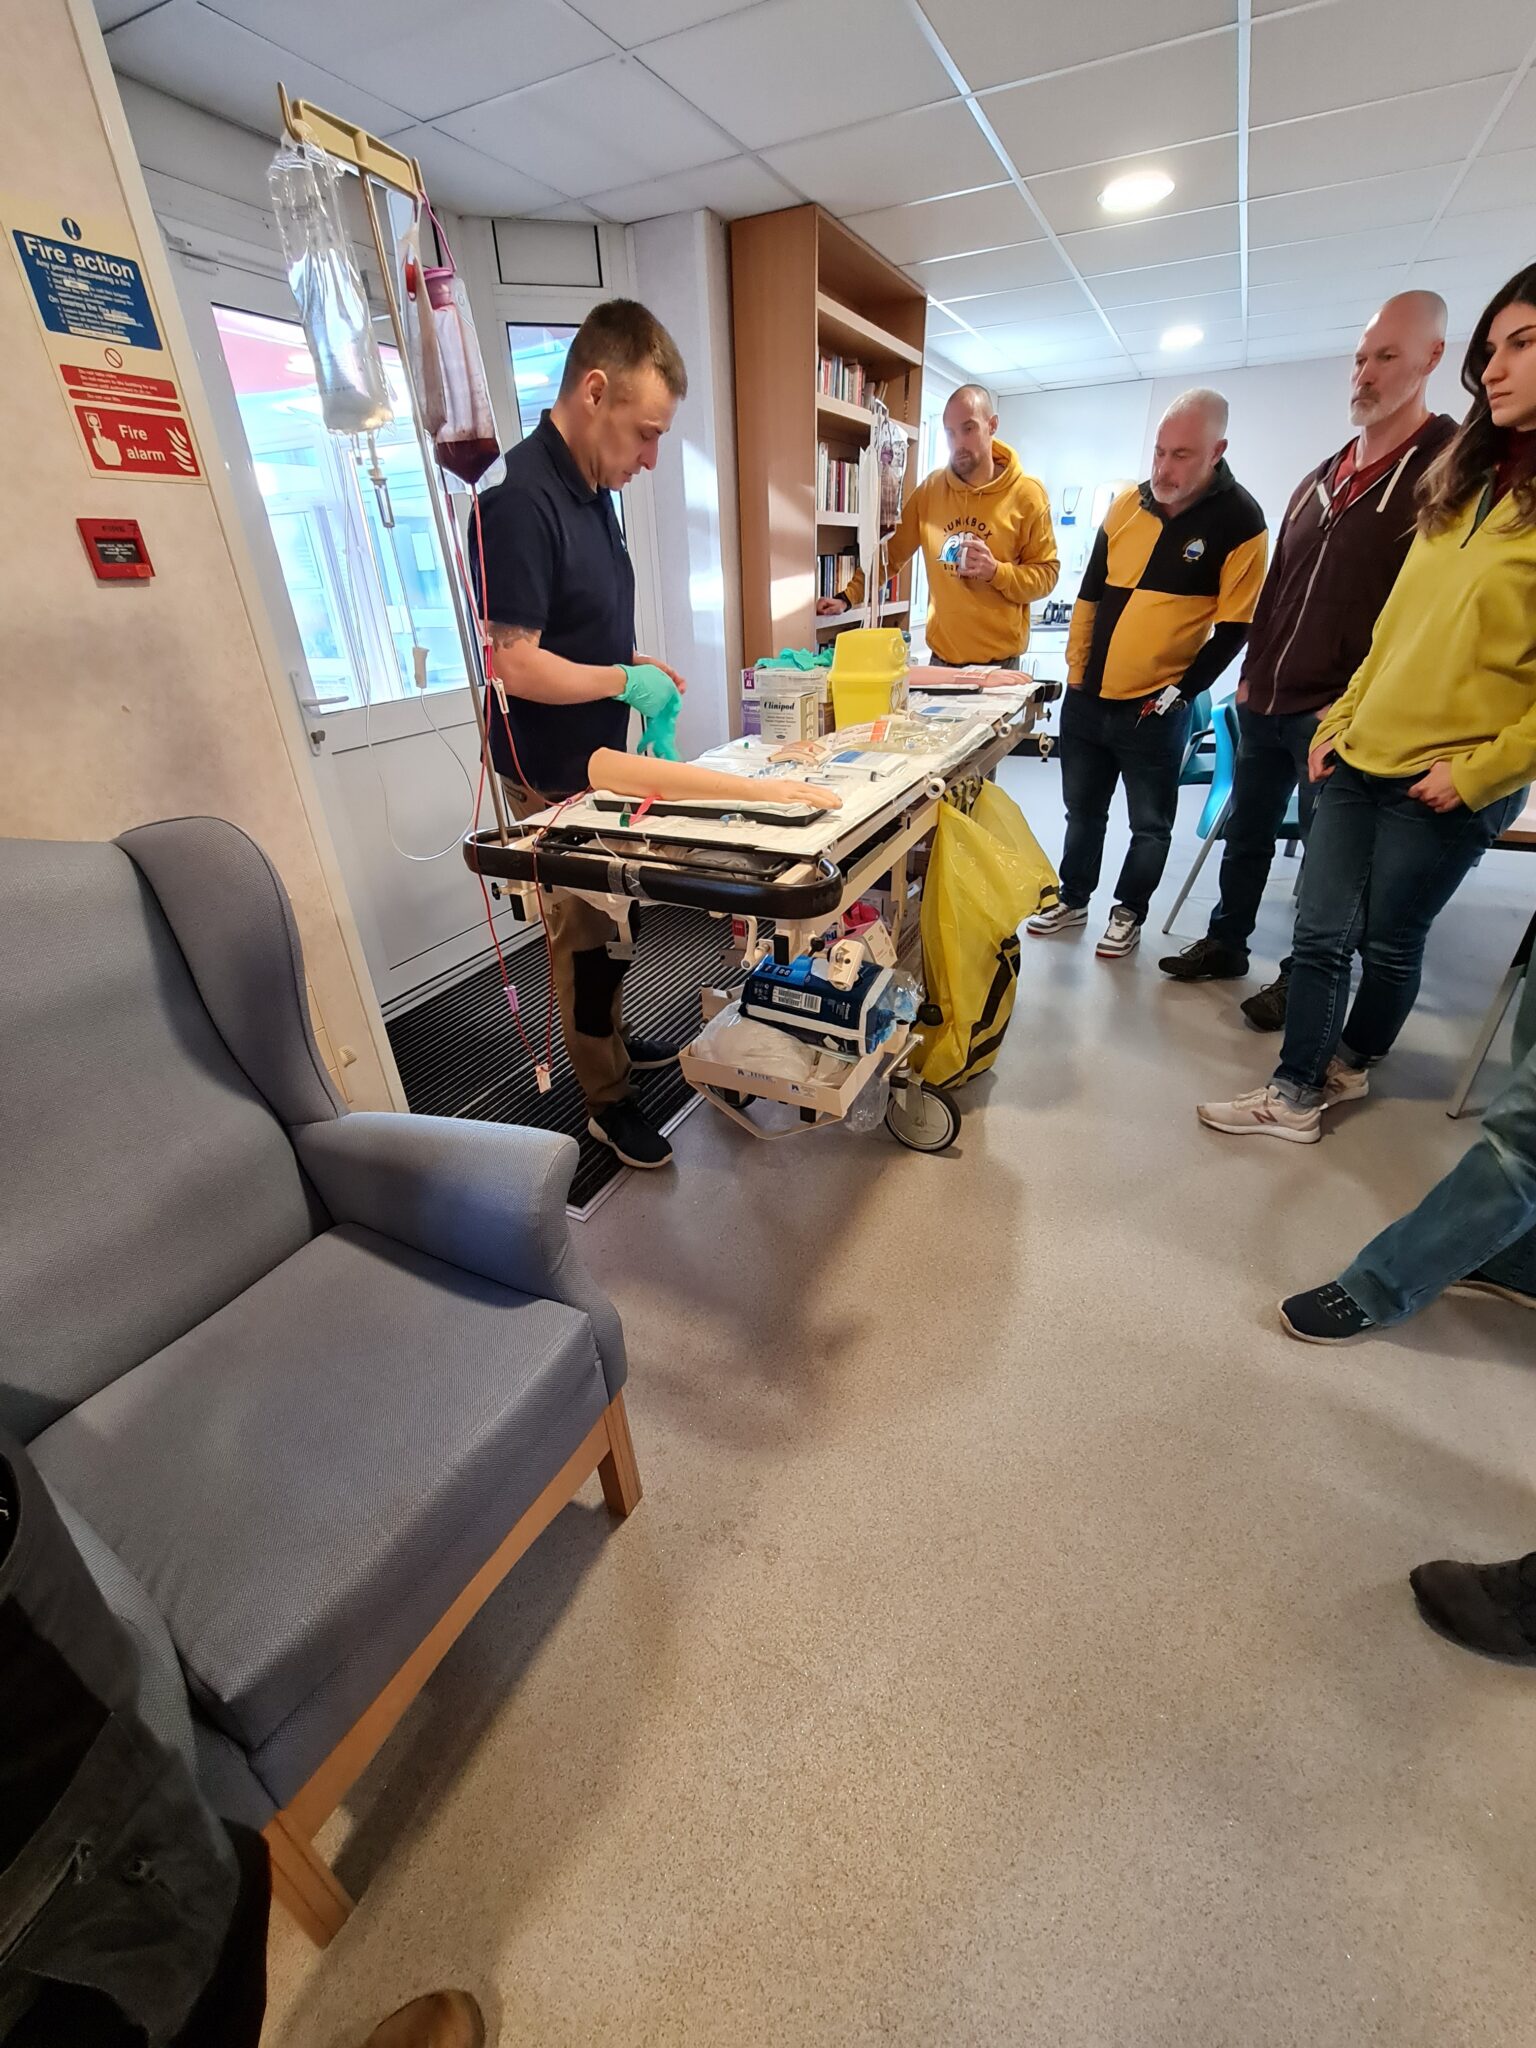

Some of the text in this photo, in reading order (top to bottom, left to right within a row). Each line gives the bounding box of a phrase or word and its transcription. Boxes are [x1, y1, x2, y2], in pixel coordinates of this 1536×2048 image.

[23, 235, 66, 264] Fire
[73, 251, 135, 280] action
[118, 424, 148, 441] Fire
[126, 447, 166, 462] alarm
[763, 701, 795, 712] Clinipod
